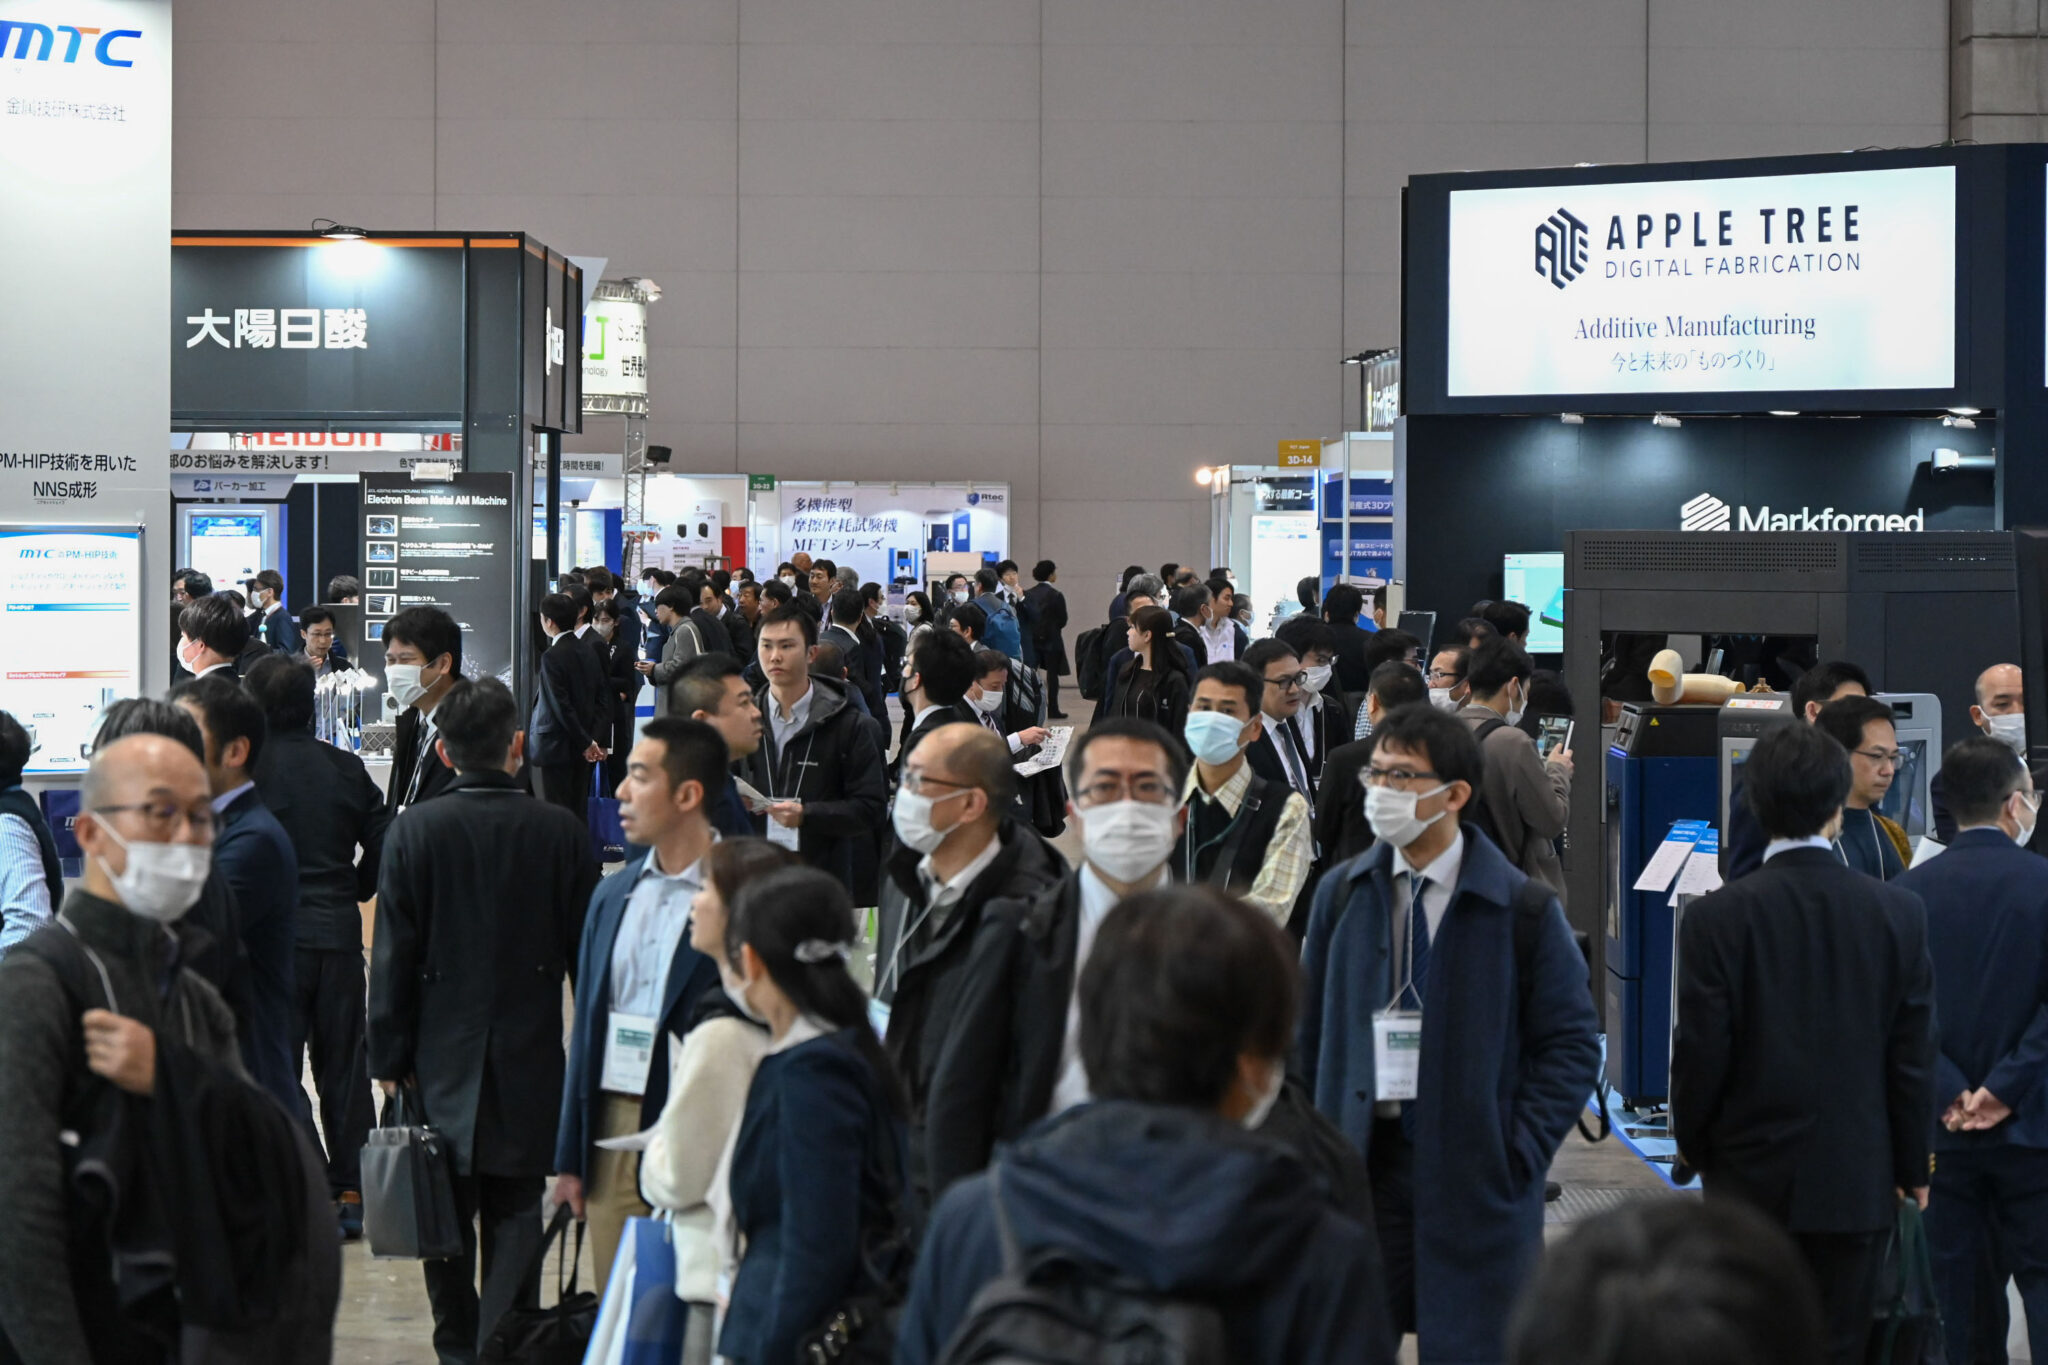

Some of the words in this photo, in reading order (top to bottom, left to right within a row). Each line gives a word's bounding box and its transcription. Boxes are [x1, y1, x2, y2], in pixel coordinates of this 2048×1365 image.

[1606, 210, 1732, 250] APPLE
[1760, 205, 1859, 244] TREE
[1605, 258, 1693, 278] DIGITAL
[1705, 253, 1860, 275] FABRICATION
[187, 308, 367, 349] 大陽日酸
[1574, 317, 1657, 340] Additive
[1665, 313, 1816, 340] Manufacturing
[1288, 455, 1312, 464] 3D-14
[33, 481, 97, 498] NNS成形
[214, 481, 267, 491] パーカー加工
[367, 495, 402, 504] Electron
[404, 495, 428, 505] Beam
[430, 496, 454, 505] Metal
[455, 496, 470, 505] AM
[472, 496, 507, 505] Machine
[794, 497, 853, 512] 多機能型
